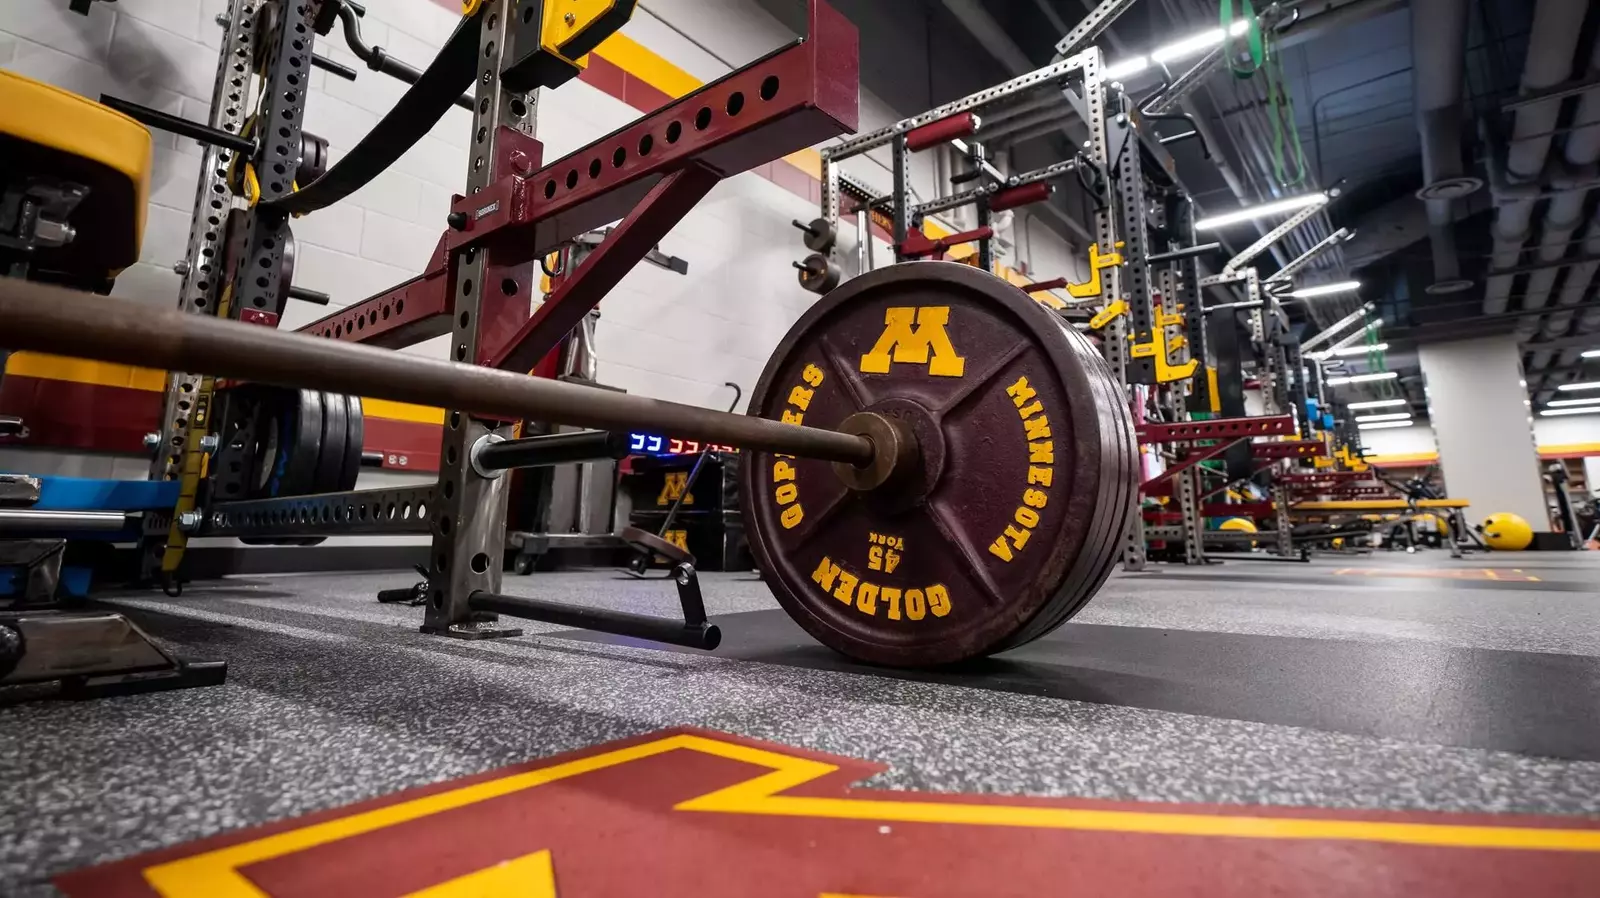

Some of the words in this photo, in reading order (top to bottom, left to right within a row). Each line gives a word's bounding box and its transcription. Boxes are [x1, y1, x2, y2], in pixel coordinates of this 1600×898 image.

[859, 306, 965, 377] M
[773, 363, 825, 530] GOPERS
[988, 376, 1055, 563] MINNESOTA
[657, 472, 694, 505] M
[868, 532, 904, 551] YORK
[868, 545, 900, 574] 45
[811, 556, 953, 621] GOLDEN
